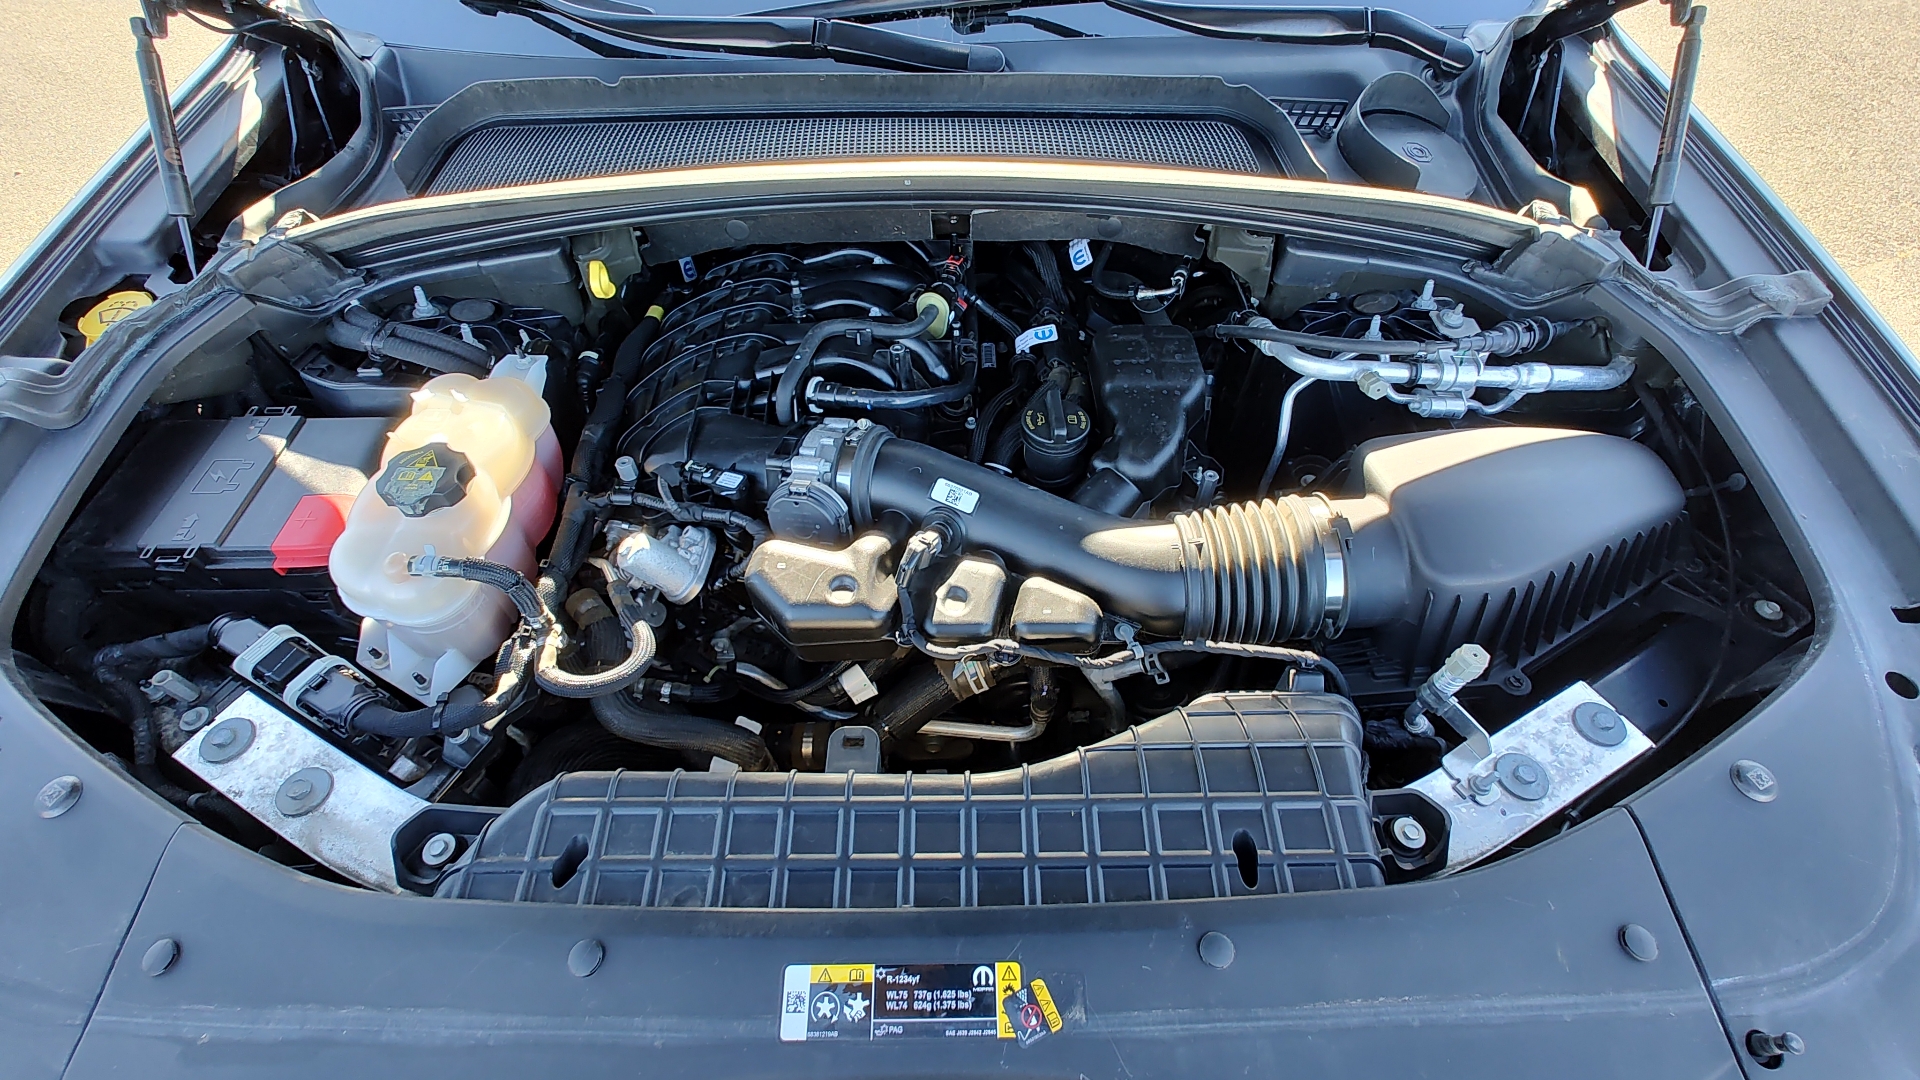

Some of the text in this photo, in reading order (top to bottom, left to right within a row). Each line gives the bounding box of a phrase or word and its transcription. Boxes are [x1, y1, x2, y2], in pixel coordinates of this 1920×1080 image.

[886, 974, 920, 986] R-1234yf
[886, 990, 972, 1000] WL75 737g (1.625 lbs)
[886, 1000, 972, 1011] WL74 624g (1.375 lbs)
[889, 1026, 903, 1035] PAG
